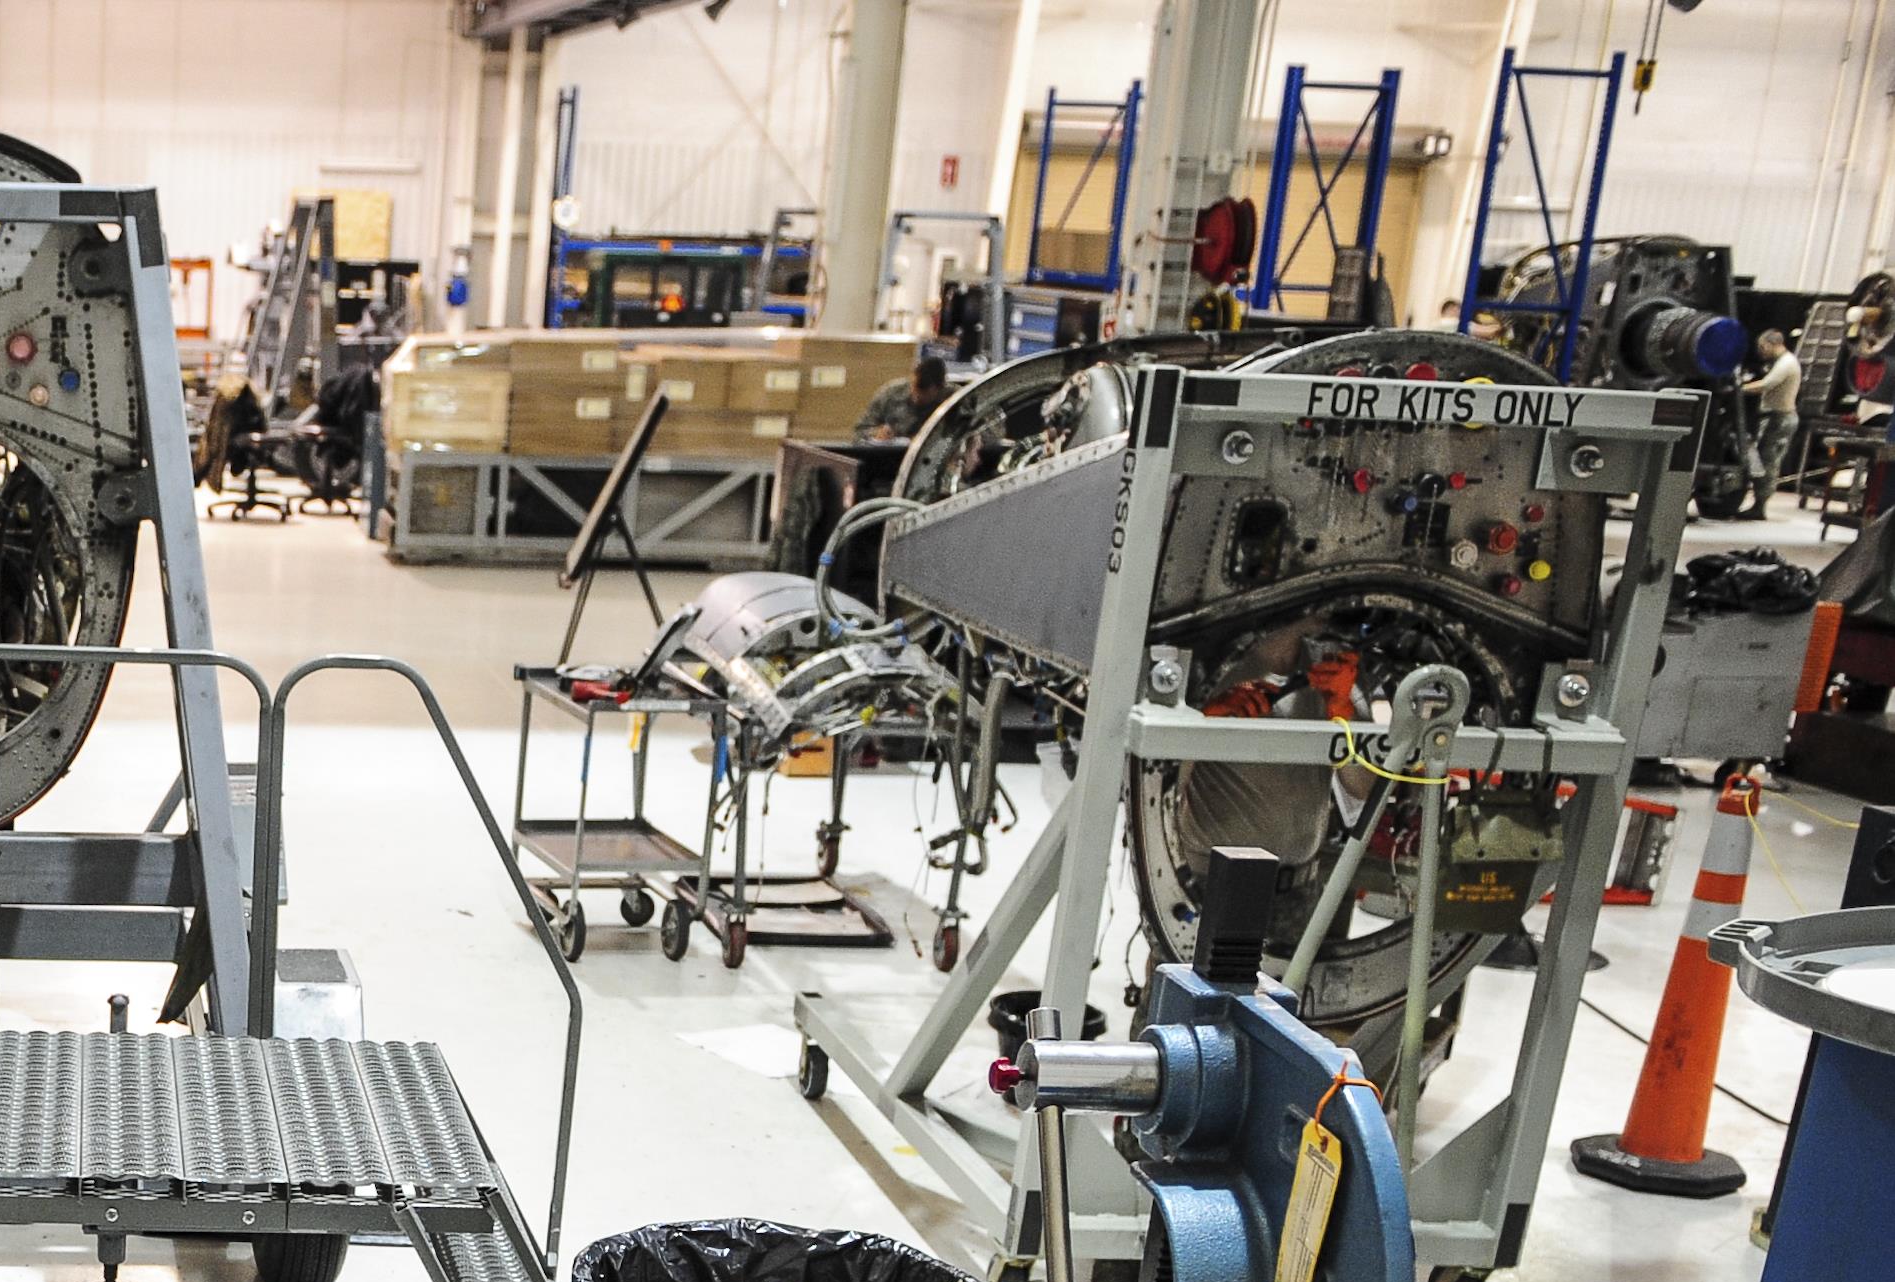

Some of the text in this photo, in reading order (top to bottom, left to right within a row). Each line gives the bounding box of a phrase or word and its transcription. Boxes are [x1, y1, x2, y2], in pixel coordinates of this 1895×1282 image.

[1307, 382, 1586, 428] FOR KITS ONLY
[1108, 450, 1137, 574] GKS03
